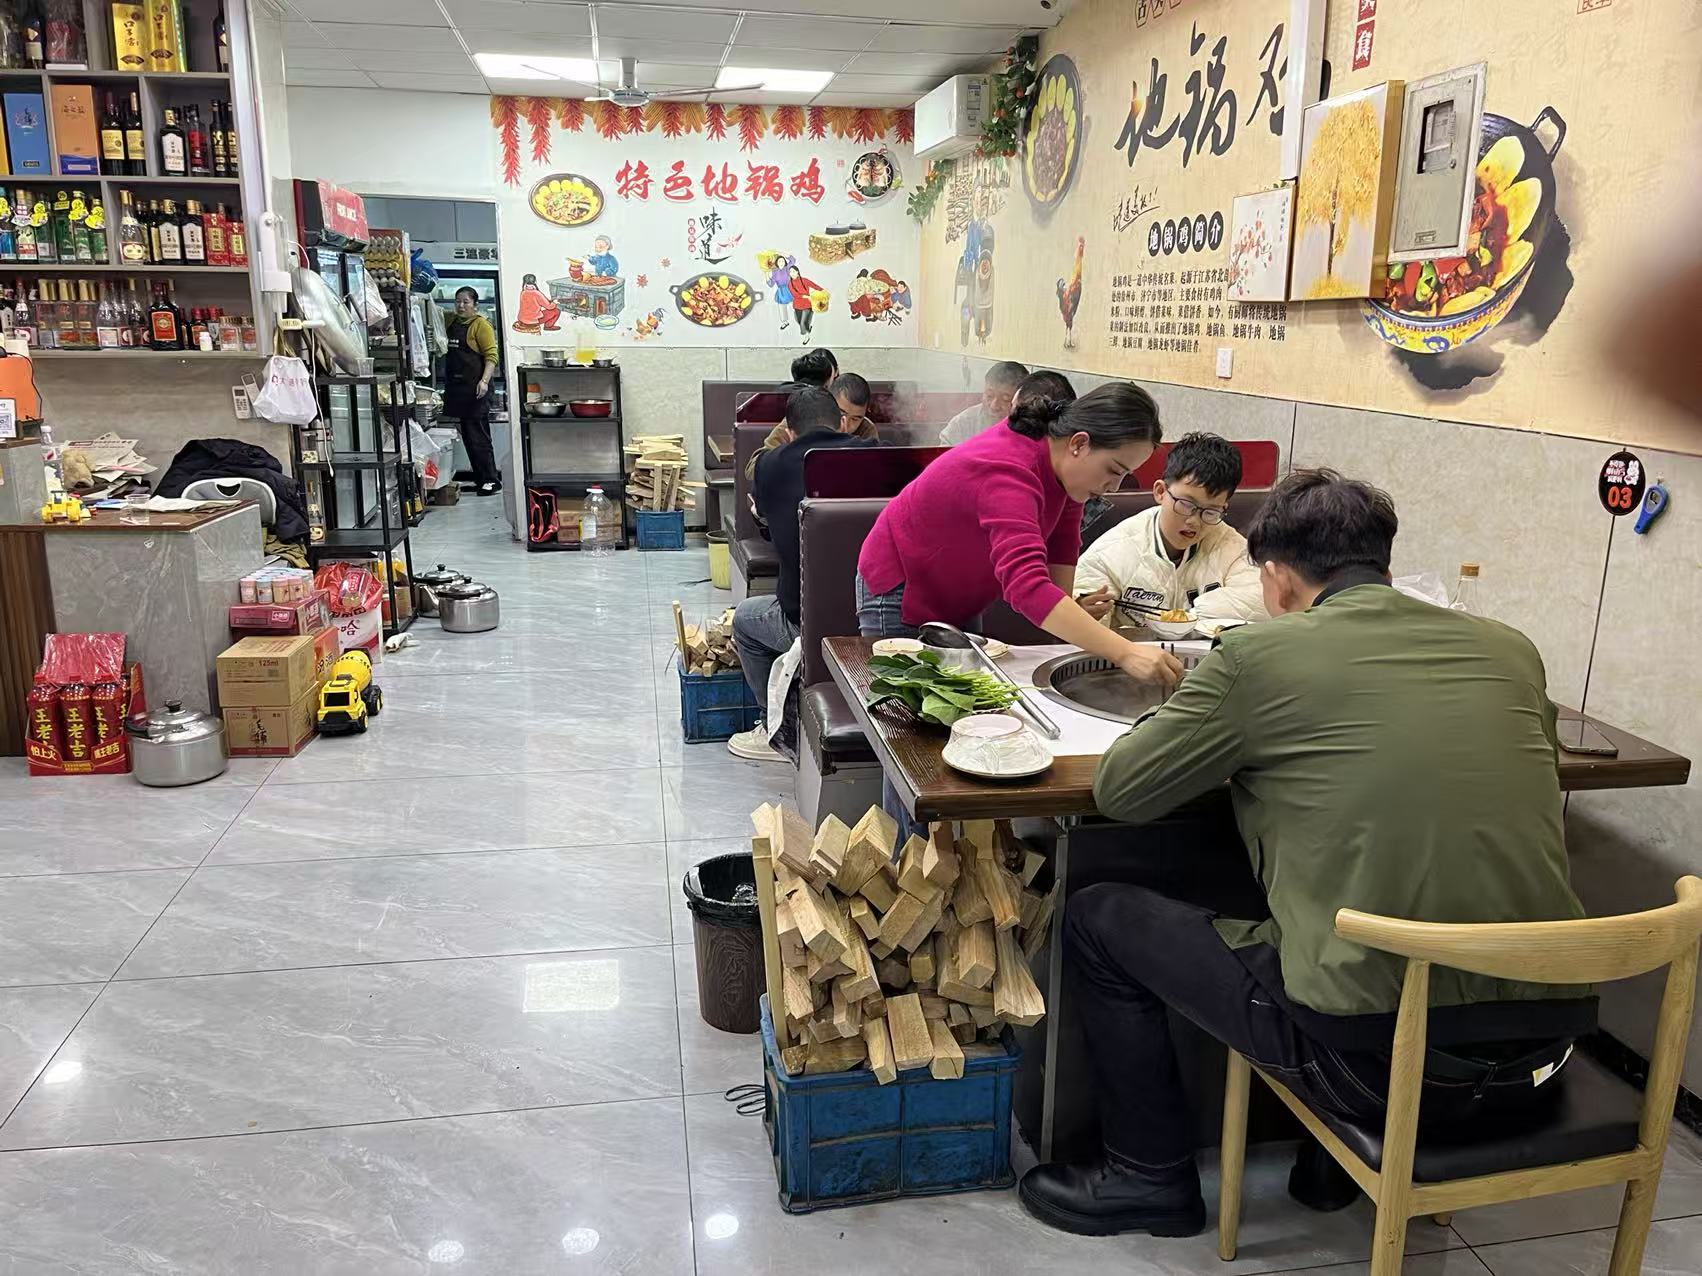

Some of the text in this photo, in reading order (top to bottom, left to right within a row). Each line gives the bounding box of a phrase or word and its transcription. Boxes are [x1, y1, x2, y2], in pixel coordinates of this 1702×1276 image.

[614, 156, 827, 205] 特色地锅鸡
[694, 206, 732, 265] 味道
[1147, 213, 1223, 254] 地锅鸡简介
[1607, 486, 1633, 509] 03
[35, 708, 54, 748] 王老
[67, 707, 86, 758] 王老吉
[30, 745, 57, 761] 怕上火
